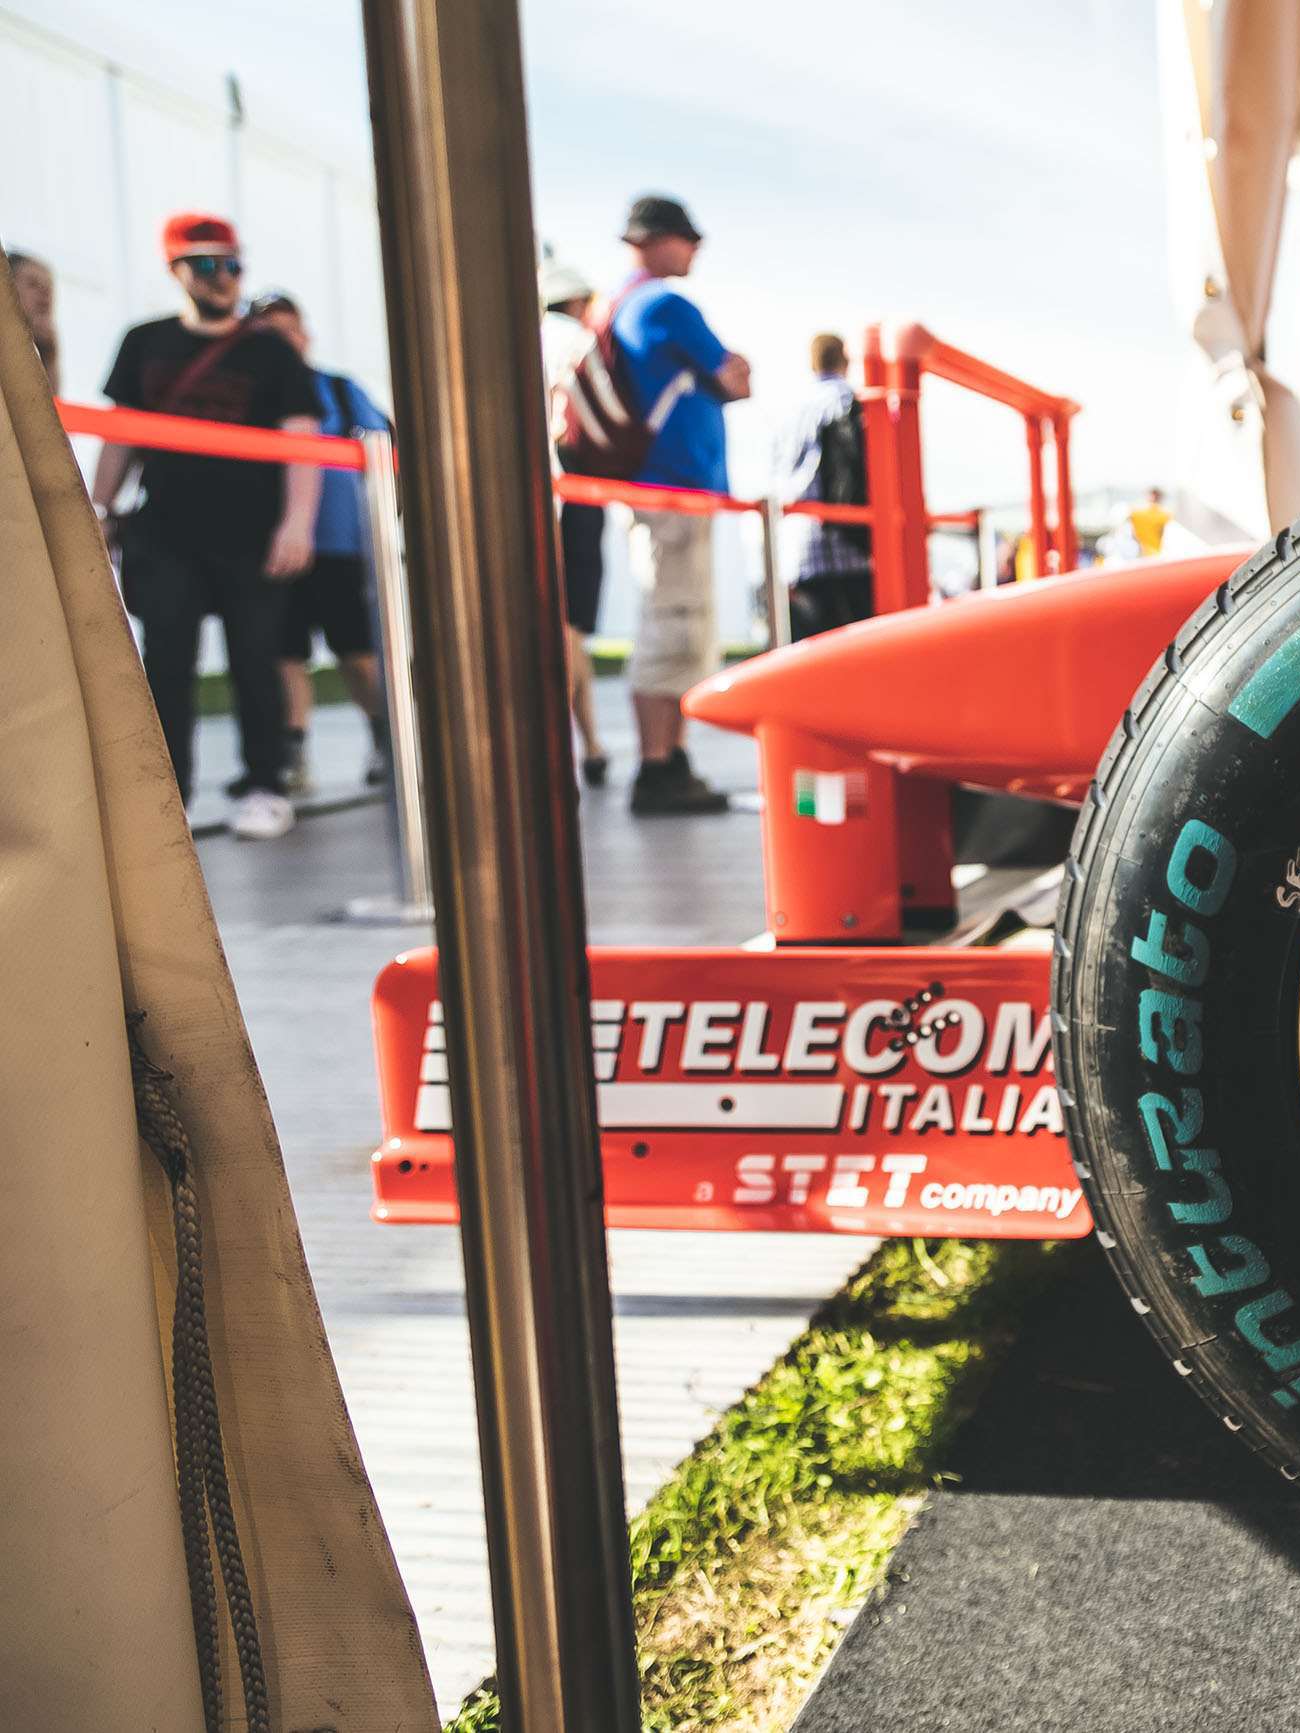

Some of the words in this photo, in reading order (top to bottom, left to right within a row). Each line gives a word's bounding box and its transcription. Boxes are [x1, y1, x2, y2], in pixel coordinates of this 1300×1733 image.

[622, 999, 1055, 1074] TELECOM
[848, 1083, 1065, 1134] ITALIA
[733, 1153, 928, 1209] STET
[919, 1182, 1084, 1220] company
